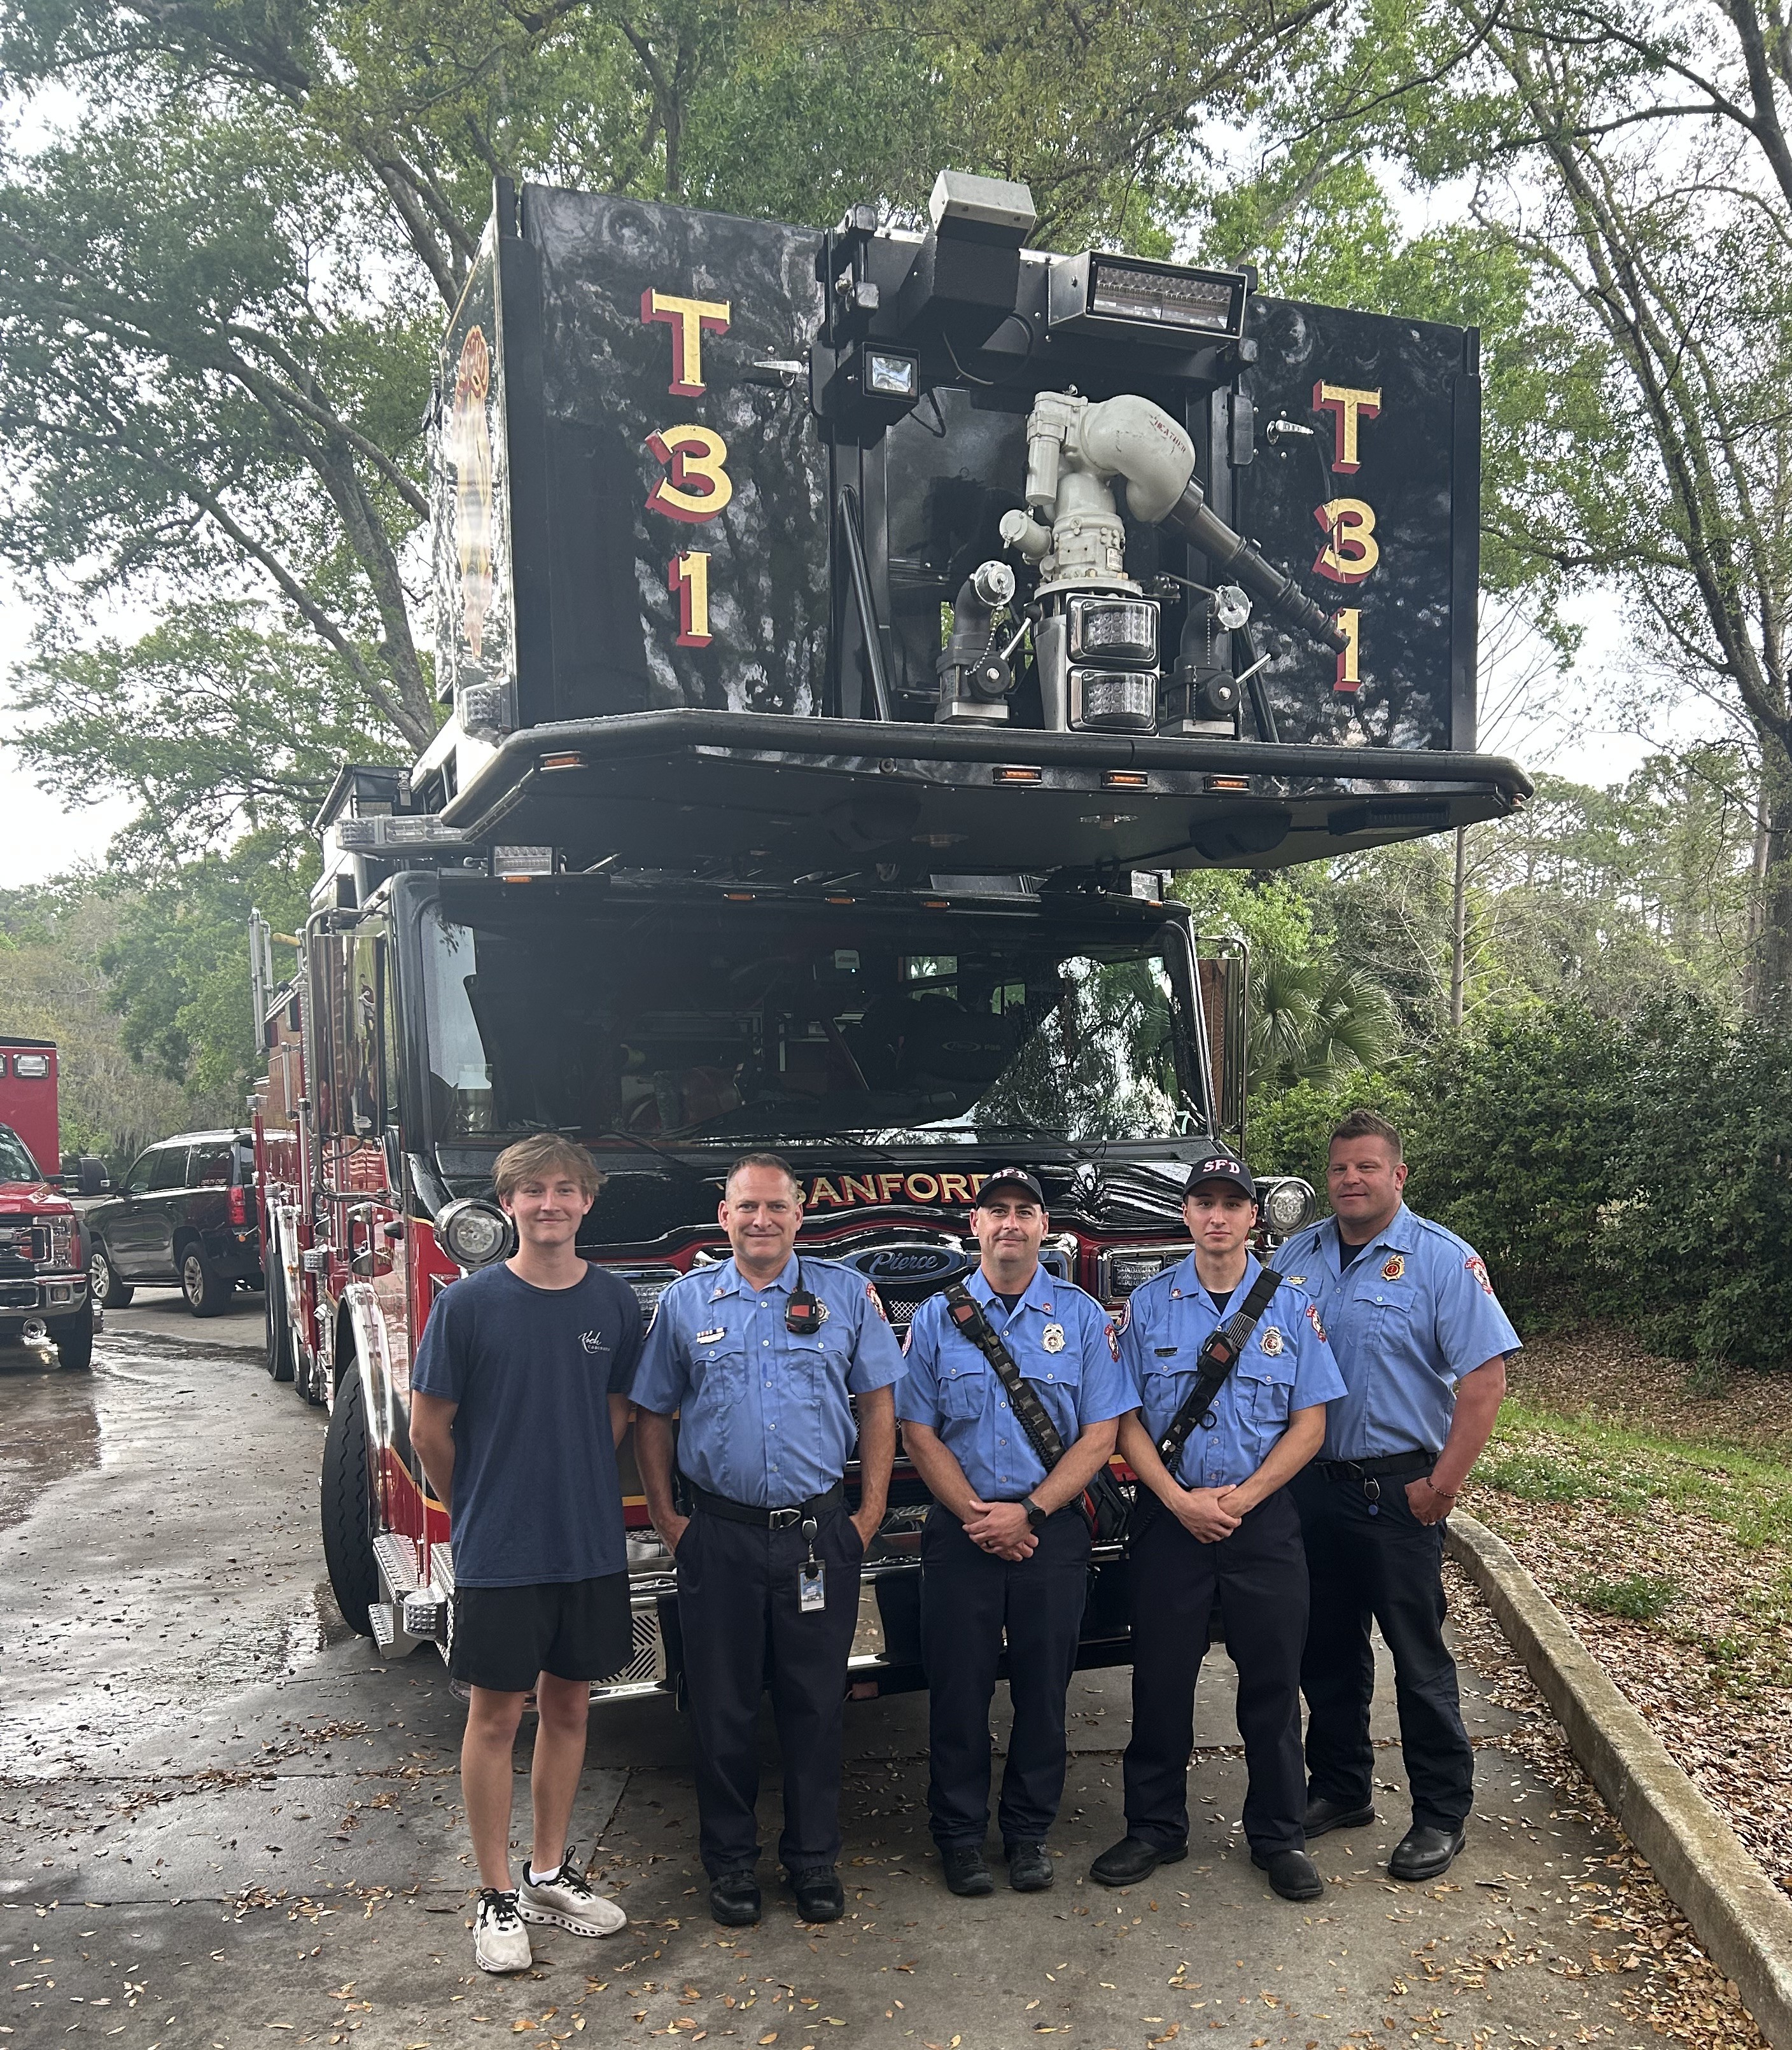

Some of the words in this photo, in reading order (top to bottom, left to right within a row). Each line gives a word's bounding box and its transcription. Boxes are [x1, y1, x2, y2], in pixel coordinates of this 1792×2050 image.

[1201, 1159, 1240, 1174] SFD
[991, 1168, 1028, 1181] SFD
[869, 1251, 938, 1274] Pierce
